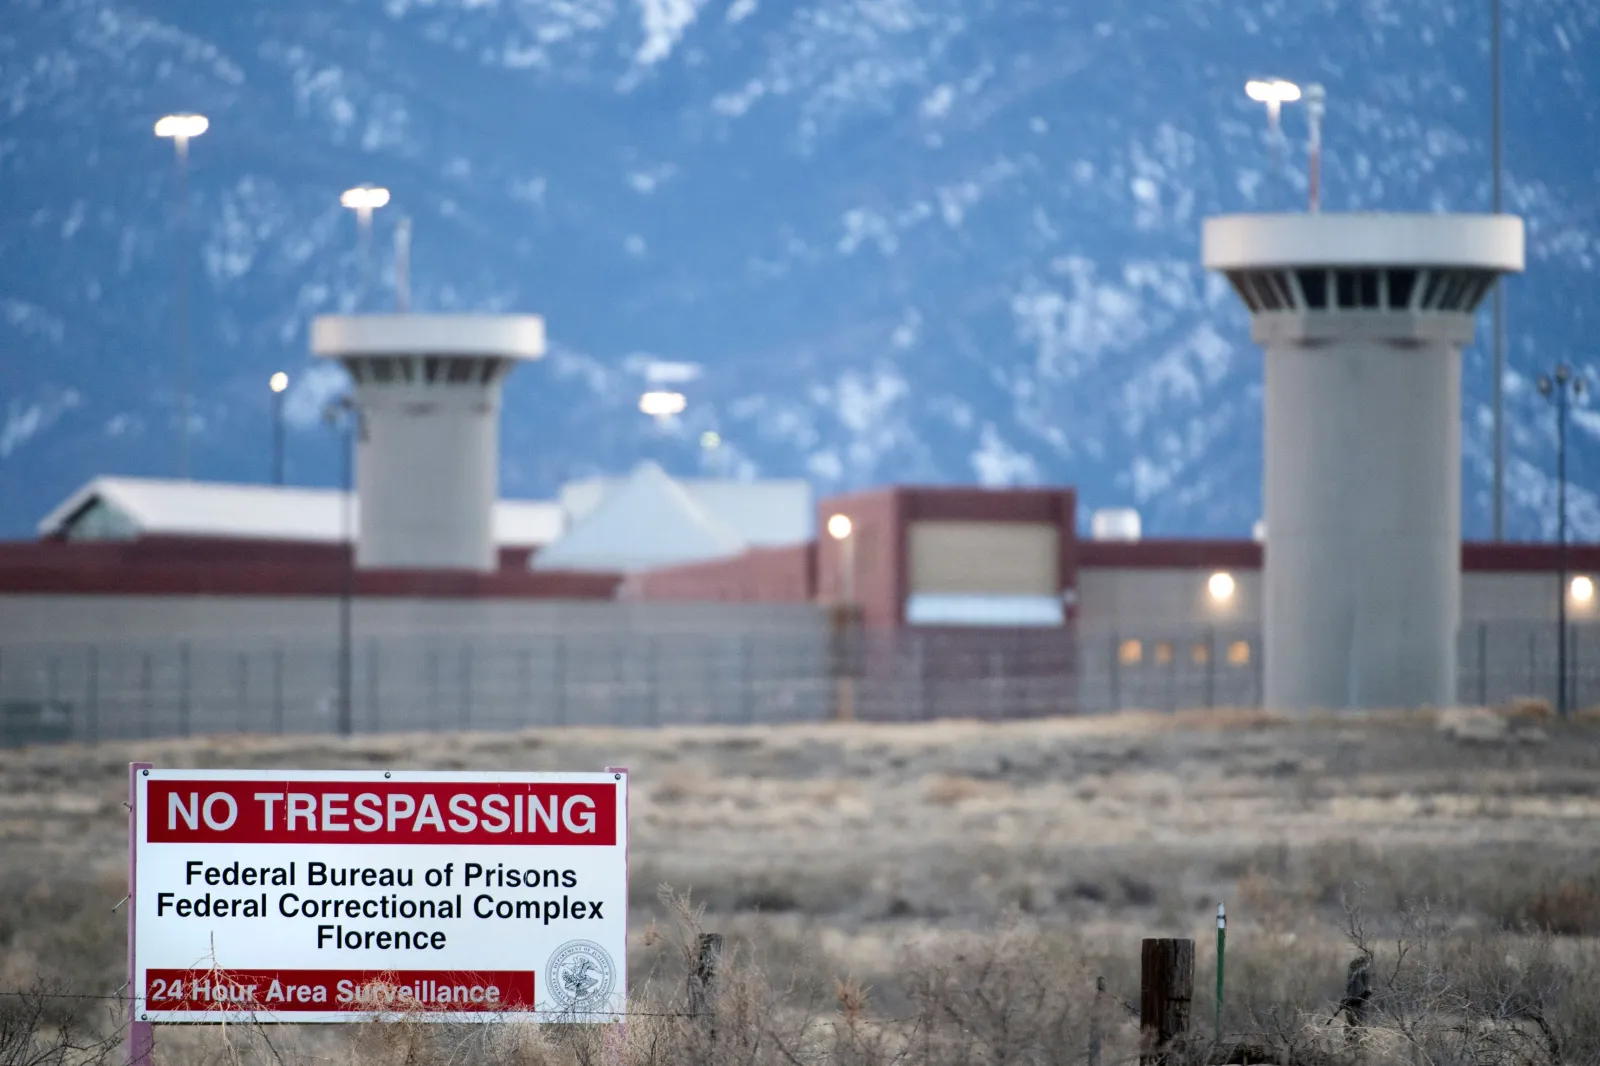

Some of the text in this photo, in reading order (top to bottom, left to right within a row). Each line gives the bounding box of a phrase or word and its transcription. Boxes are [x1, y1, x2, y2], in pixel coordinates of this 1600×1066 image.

[168, 791, 597, 834] NO TRESPASSING
[186, 860, 577, 888] Federal Bureau of Prisons
[157, 892, 604, 926] Federal Correctional Complex
[317, 924, 447, 950] Florence
[151, 978, 184, 1001] 24
[192, 979, 257, 1002] Hour
[266, 979, 327, 1003] Area
